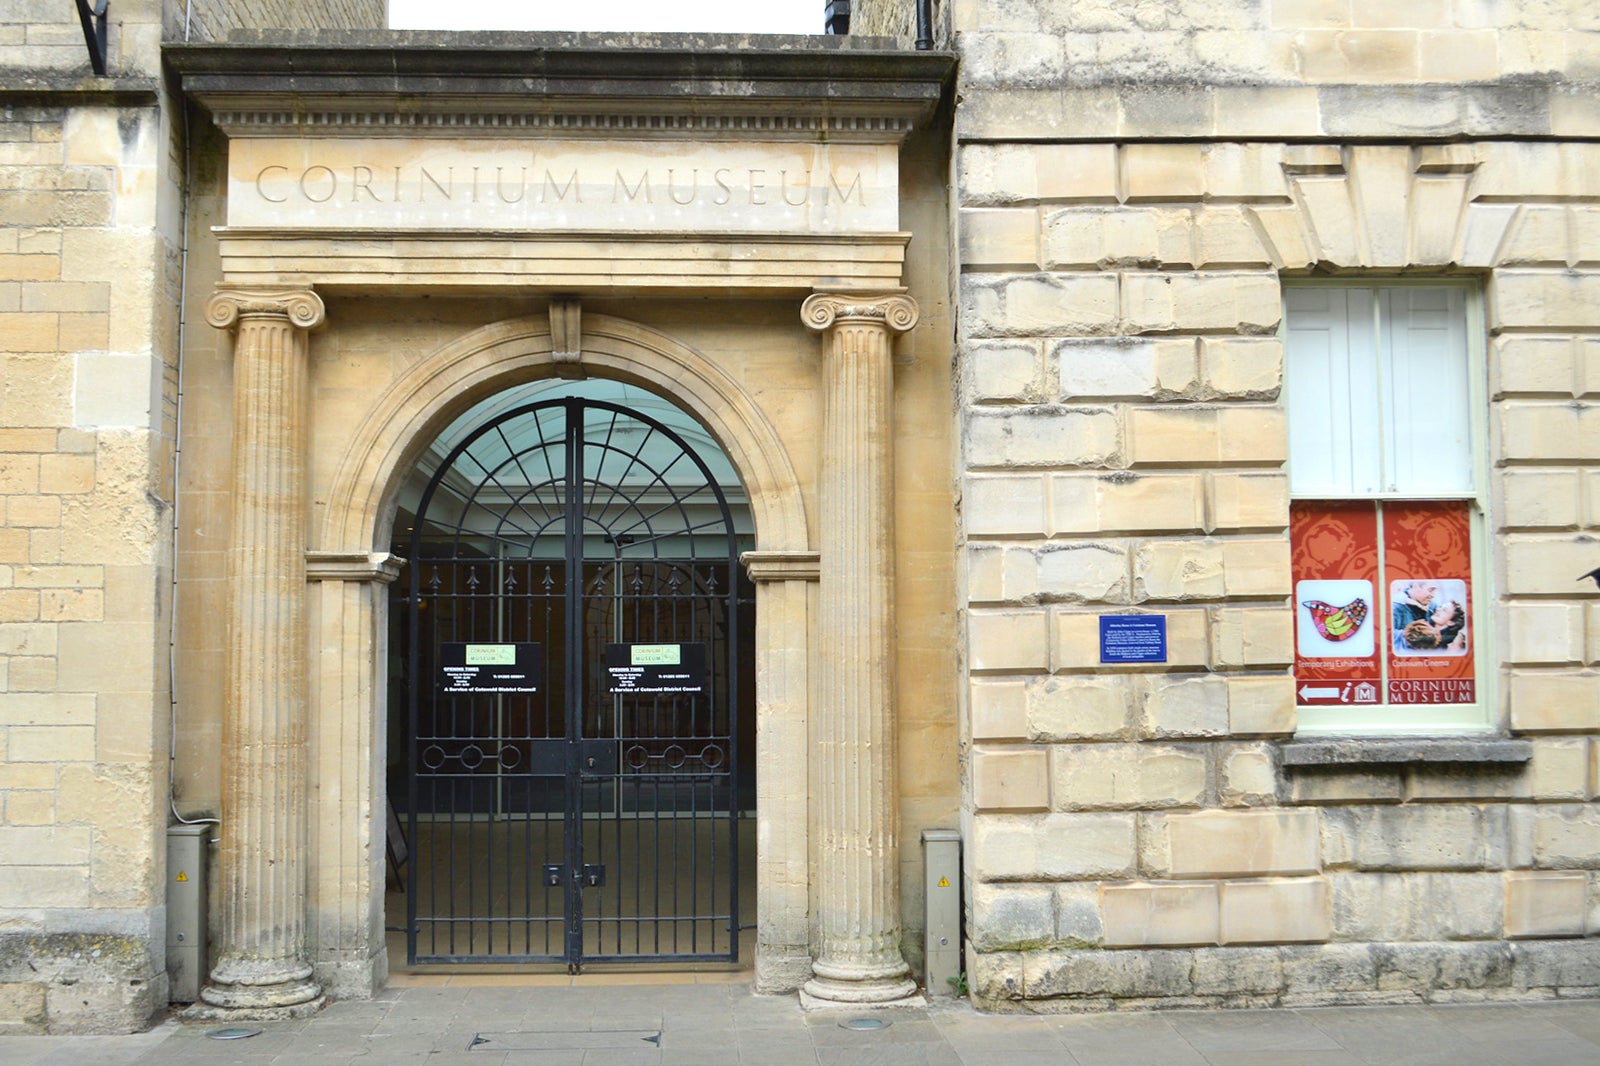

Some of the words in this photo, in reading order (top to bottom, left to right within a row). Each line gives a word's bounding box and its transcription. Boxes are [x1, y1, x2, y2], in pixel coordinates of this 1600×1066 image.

[256, 165, 583, 204] CORINIUM
[611, 168, 867, 207] MUSEUM
[1298, 660, 1335, 669] Temporary
[1390, 681, 1471, 692] CORINIUM
[1391, 692, 1472, 703] MUSEUM
